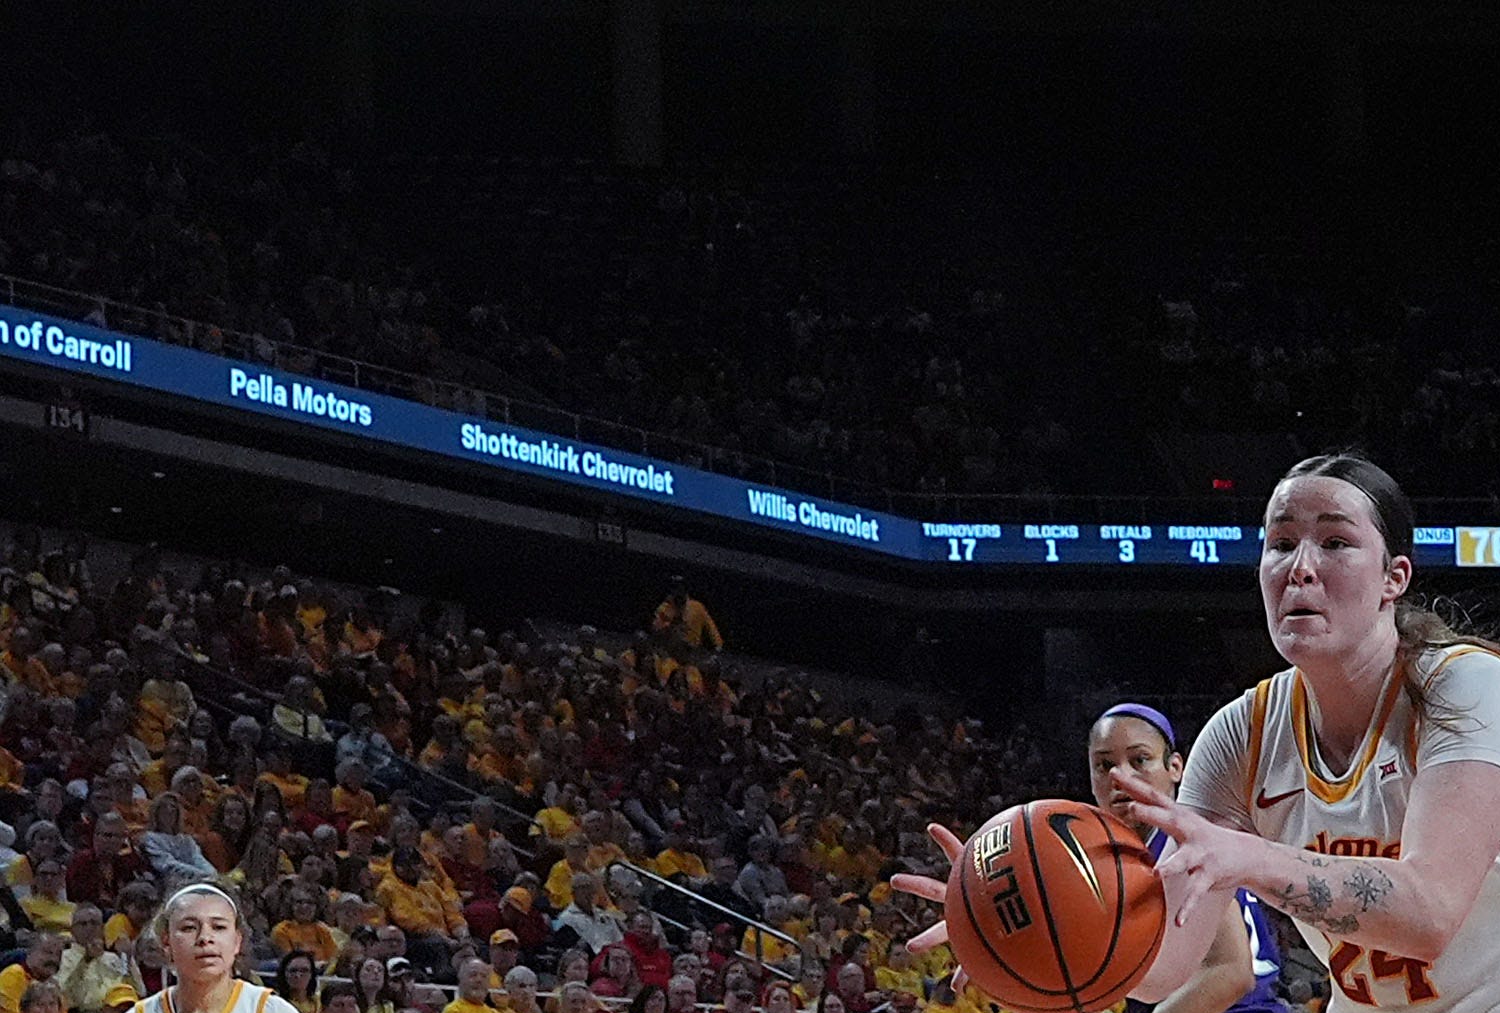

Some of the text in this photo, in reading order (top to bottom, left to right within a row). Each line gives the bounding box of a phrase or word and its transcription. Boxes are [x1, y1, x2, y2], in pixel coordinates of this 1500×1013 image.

[14, 322, 43, 351] of
[46, 326, 131, 372] Carroll
[231, 368, 372, 426] Pella Motors
[461, 423, 673, 495] Shottenkirk Chevrolet
[748, 488, 879, 541] Willis Chevrolet
[923, 523, 1001, 538] TURNOVERS
[1024, 524, 1079, 539] BLOCKS
[1101, 526, 1151, 539] STEALS
[1169, 526, 1241, 540] REBOUNDS
[1416, 528, 1451, 540] ONUS
[949, 538, 1219, 563] 17 1 3 41
